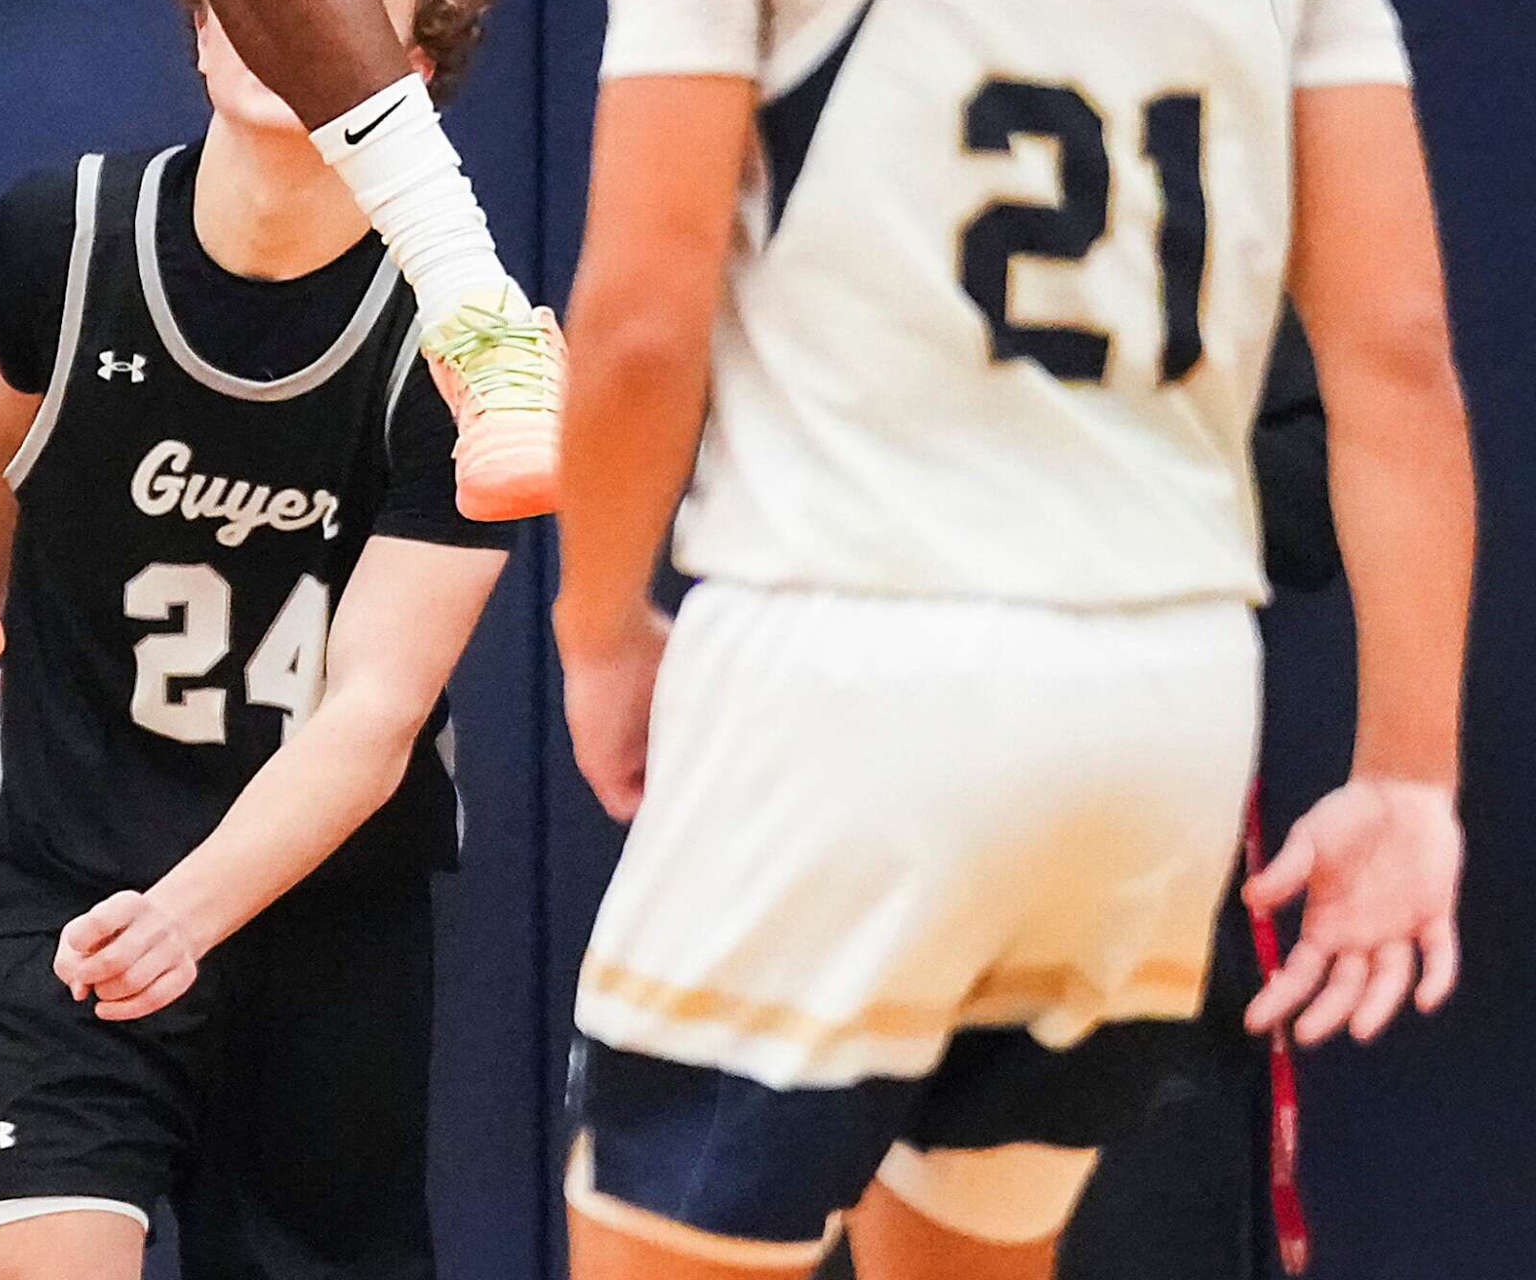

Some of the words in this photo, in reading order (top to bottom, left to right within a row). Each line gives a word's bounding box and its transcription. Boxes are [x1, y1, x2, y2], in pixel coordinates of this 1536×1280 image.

[957, 72, 1208, 386] 21
[131, 440, 339, 547] Guyer
[123, 562, 331, 746] 24
